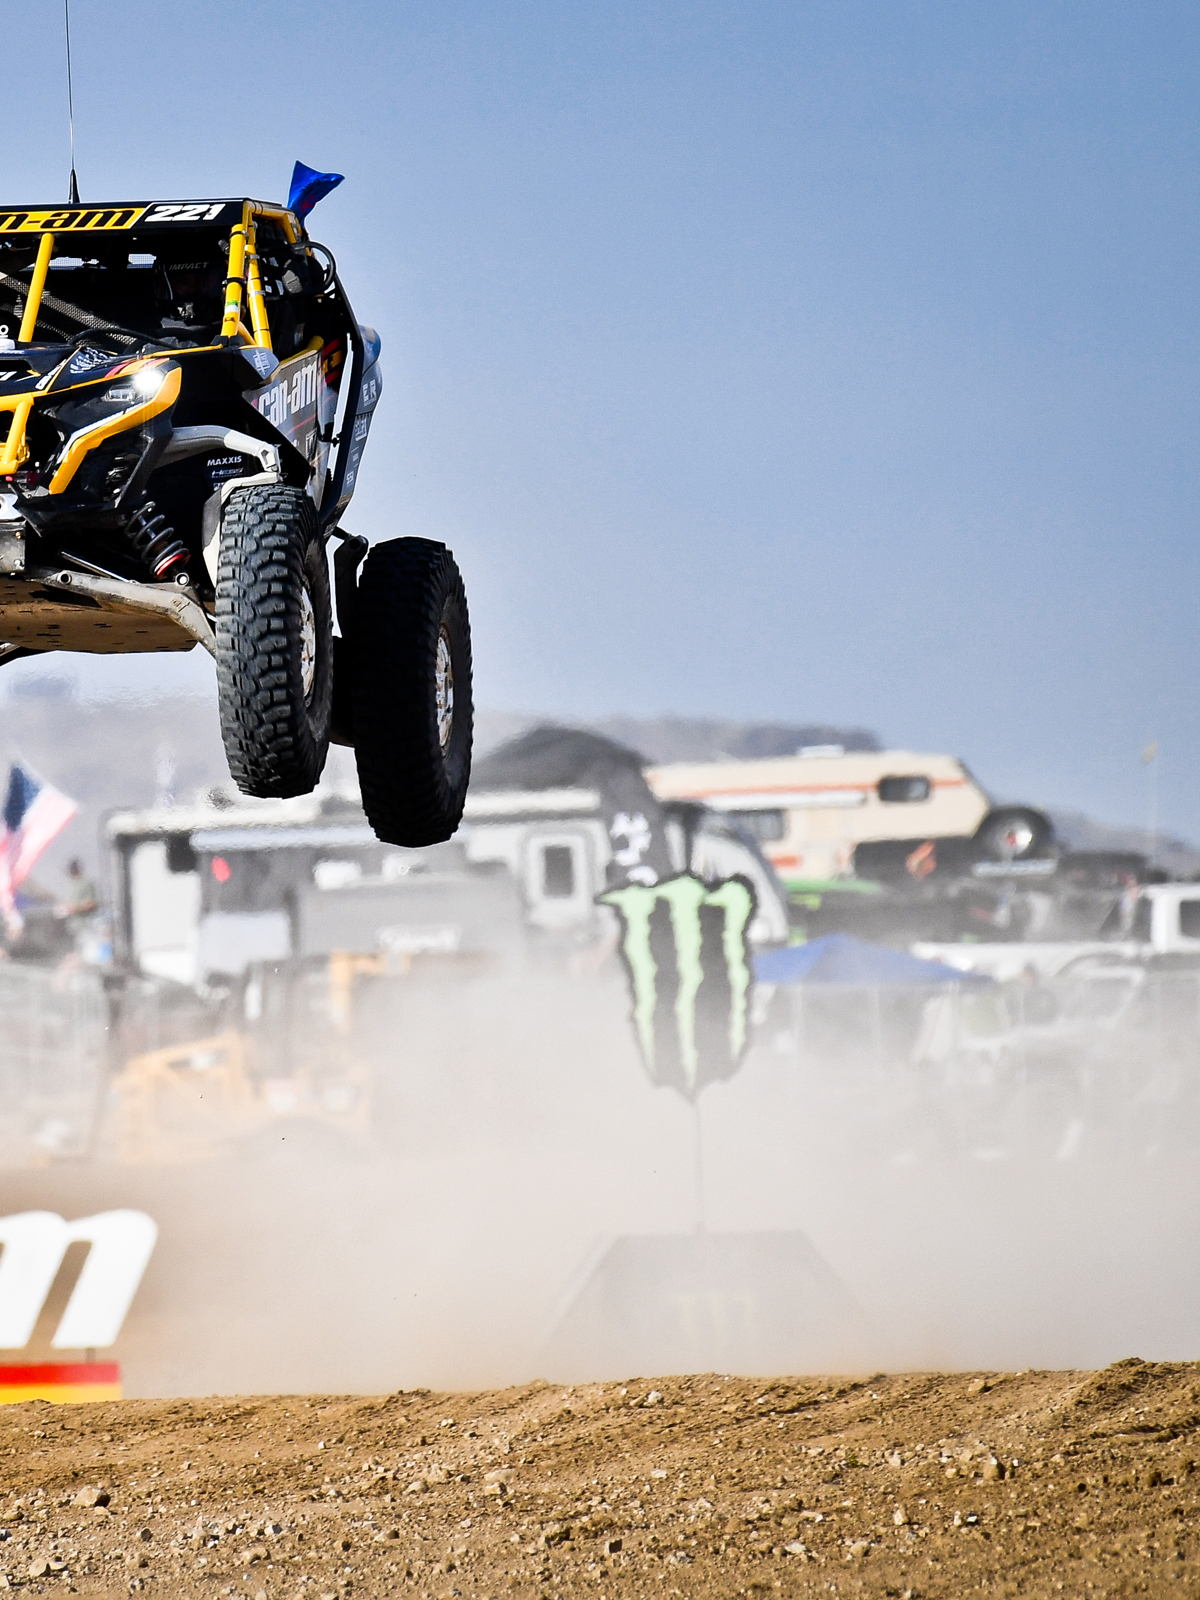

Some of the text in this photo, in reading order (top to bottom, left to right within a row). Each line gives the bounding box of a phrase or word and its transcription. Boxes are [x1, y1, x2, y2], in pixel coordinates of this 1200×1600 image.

[145, 204, 225, 222] 221
[169, 261, 209, 270] IMPACT
[259, 361, 317, 427] can-am
[207, 455, 242, 467] MAXXIS
